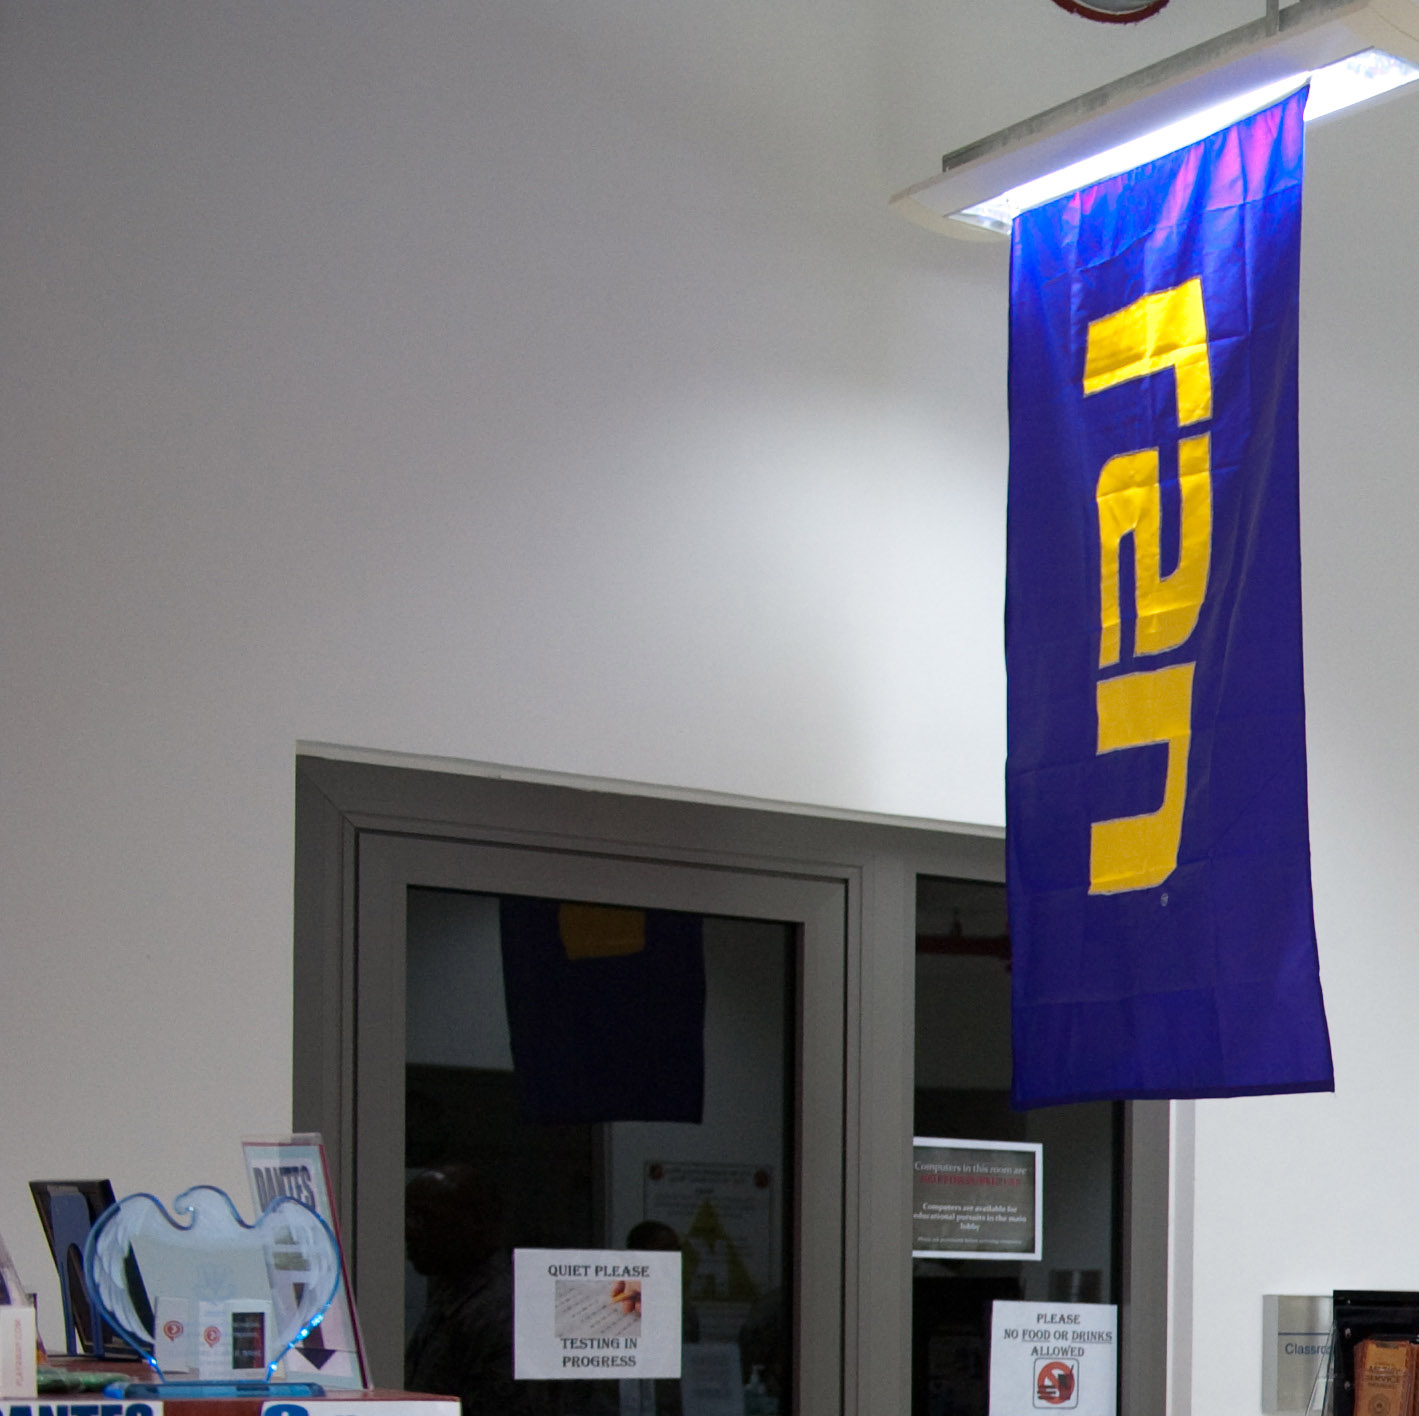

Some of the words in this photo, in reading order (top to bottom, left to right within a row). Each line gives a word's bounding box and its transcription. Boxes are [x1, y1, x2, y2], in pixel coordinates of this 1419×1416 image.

[548, 1265, 592, 1279] QUIET
[594, 1265, 650, 1278] PLEASE
[1036, 1313, 1081, 1326] PLEASE
[1004, 1329, 1020, 1341] NO
[1022, 1329, 1051, 1342] FOOD
[1053, 1330, 1070, 1342] OR
[1072, 1331, 1113, 1343] DRINKS
[561, 1338, 620, 1349] TESTING
[624, 1338, 638, 1349] IN
[1285, 1343, 1331, 1355] Classroo
[1031, 1345, 1085, 1358] ALLOWED
[562, 1355, 637, 1368] PROGRESS
